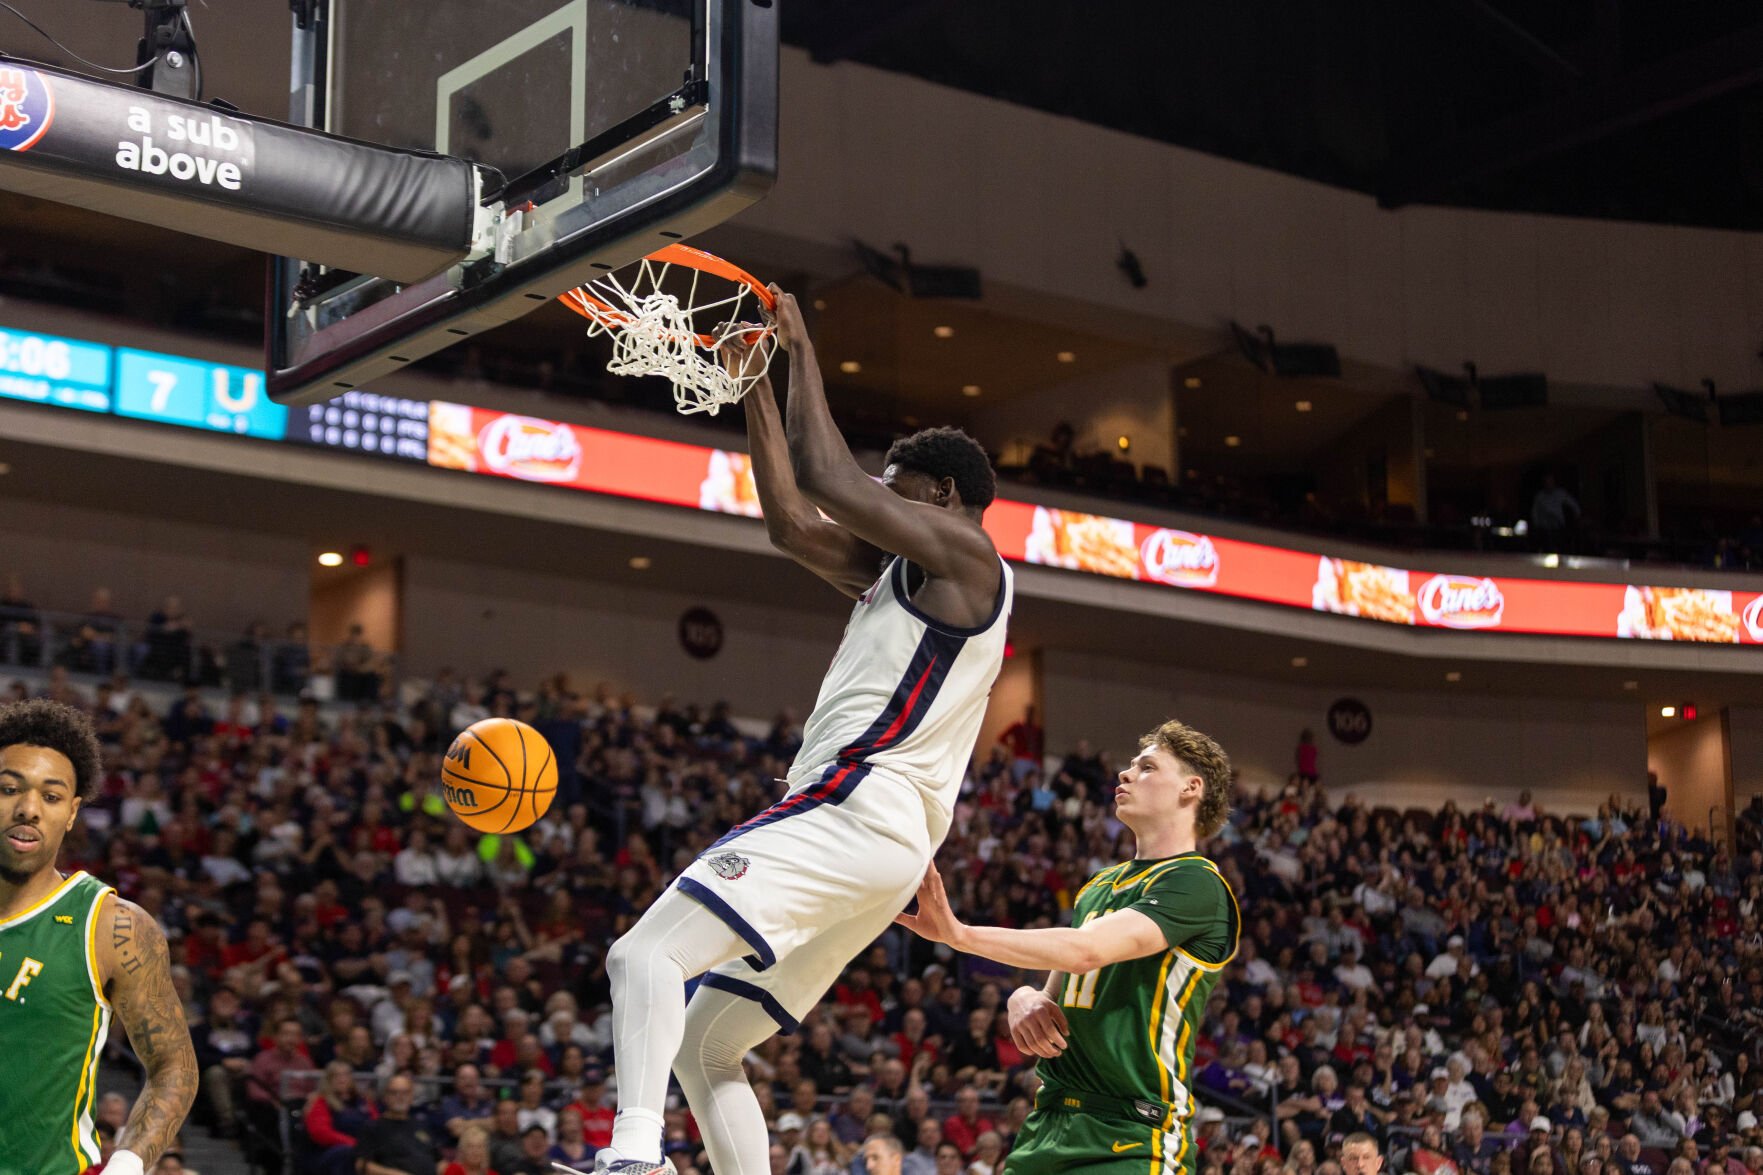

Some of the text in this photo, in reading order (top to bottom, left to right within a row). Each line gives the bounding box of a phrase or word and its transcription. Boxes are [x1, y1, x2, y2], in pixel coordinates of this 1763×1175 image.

[127, 106, 240, 151] a sub
[115, 136, 242, 190] above
[147, 369, 179, 413] 7
[1422, 575, 1500, 624] Cane's
